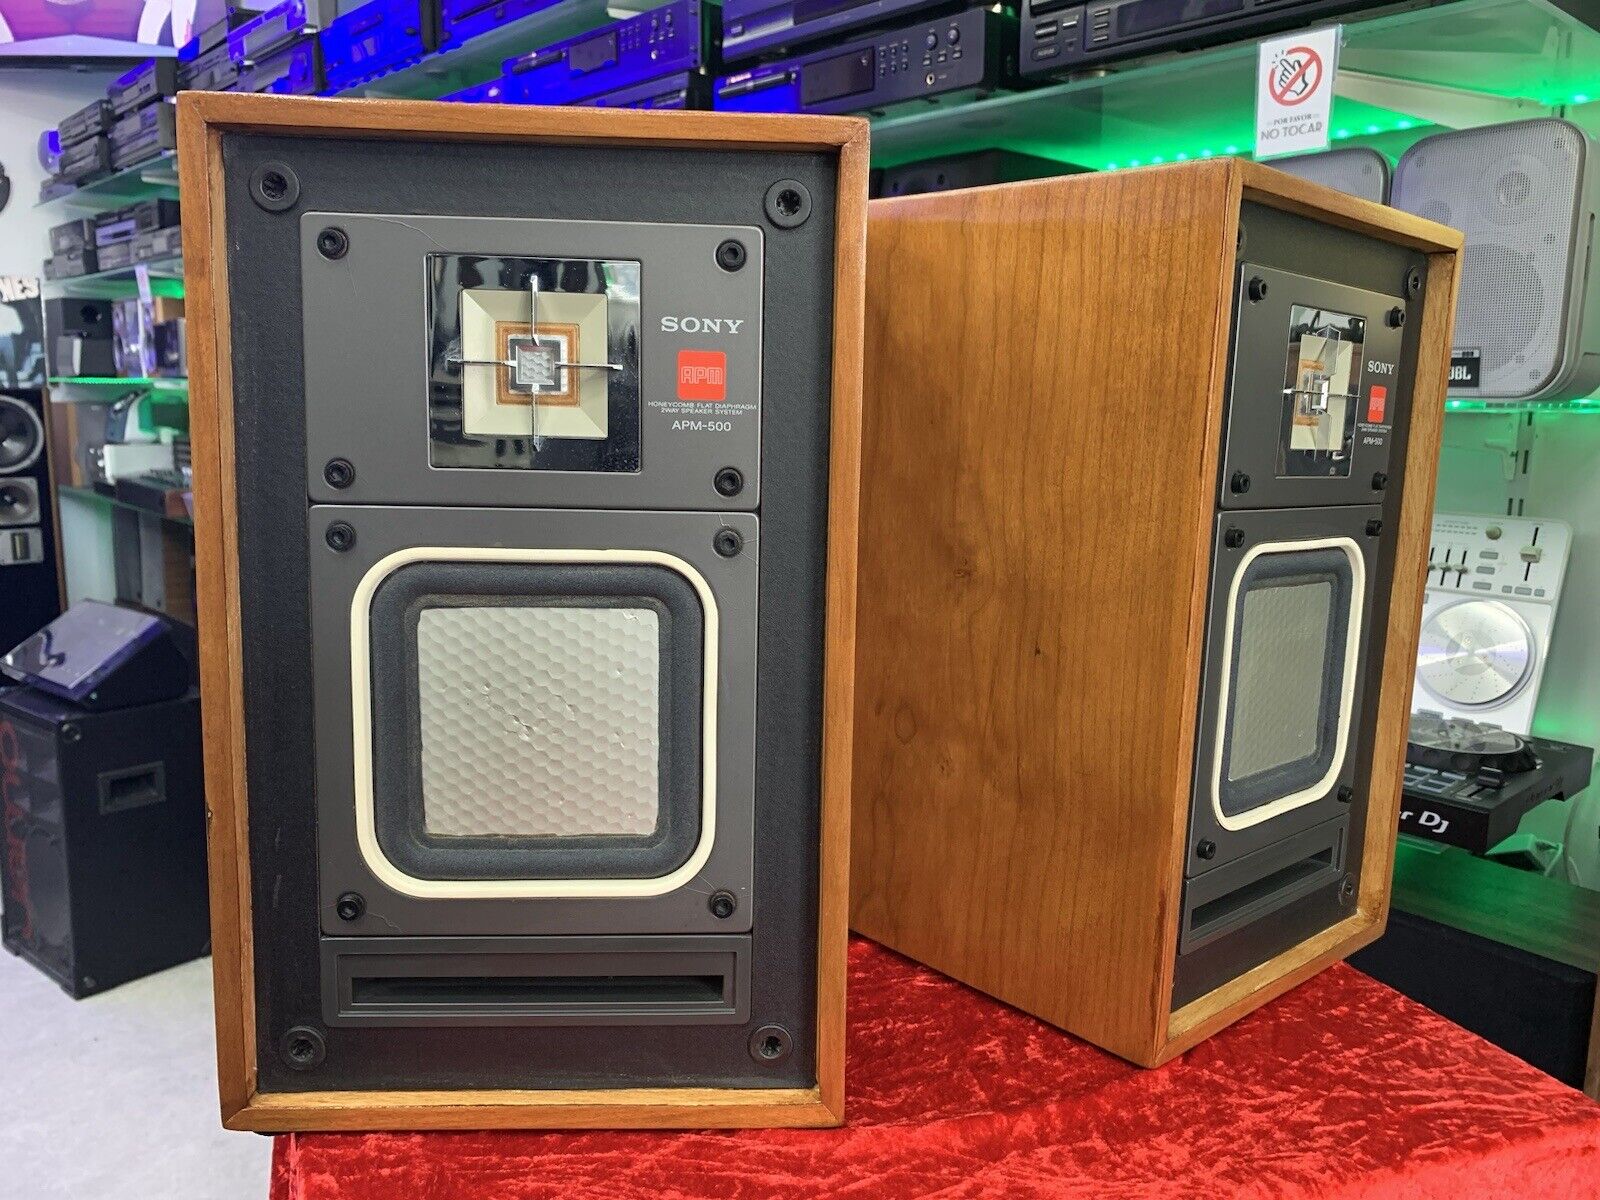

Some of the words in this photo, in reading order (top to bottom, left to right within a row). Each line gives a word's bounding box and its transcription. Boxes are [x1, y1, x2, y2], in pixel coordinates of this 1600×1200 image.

[1261, 128, 1280, 140] NO
[660, 316, 744, 334] SONY
[1367, 360, 1394, 375] SONY
[1448, 365, 1472, 381] JBL
[681, 366, 723, 385] APM
[671, 419, 732, 432] APM-500
